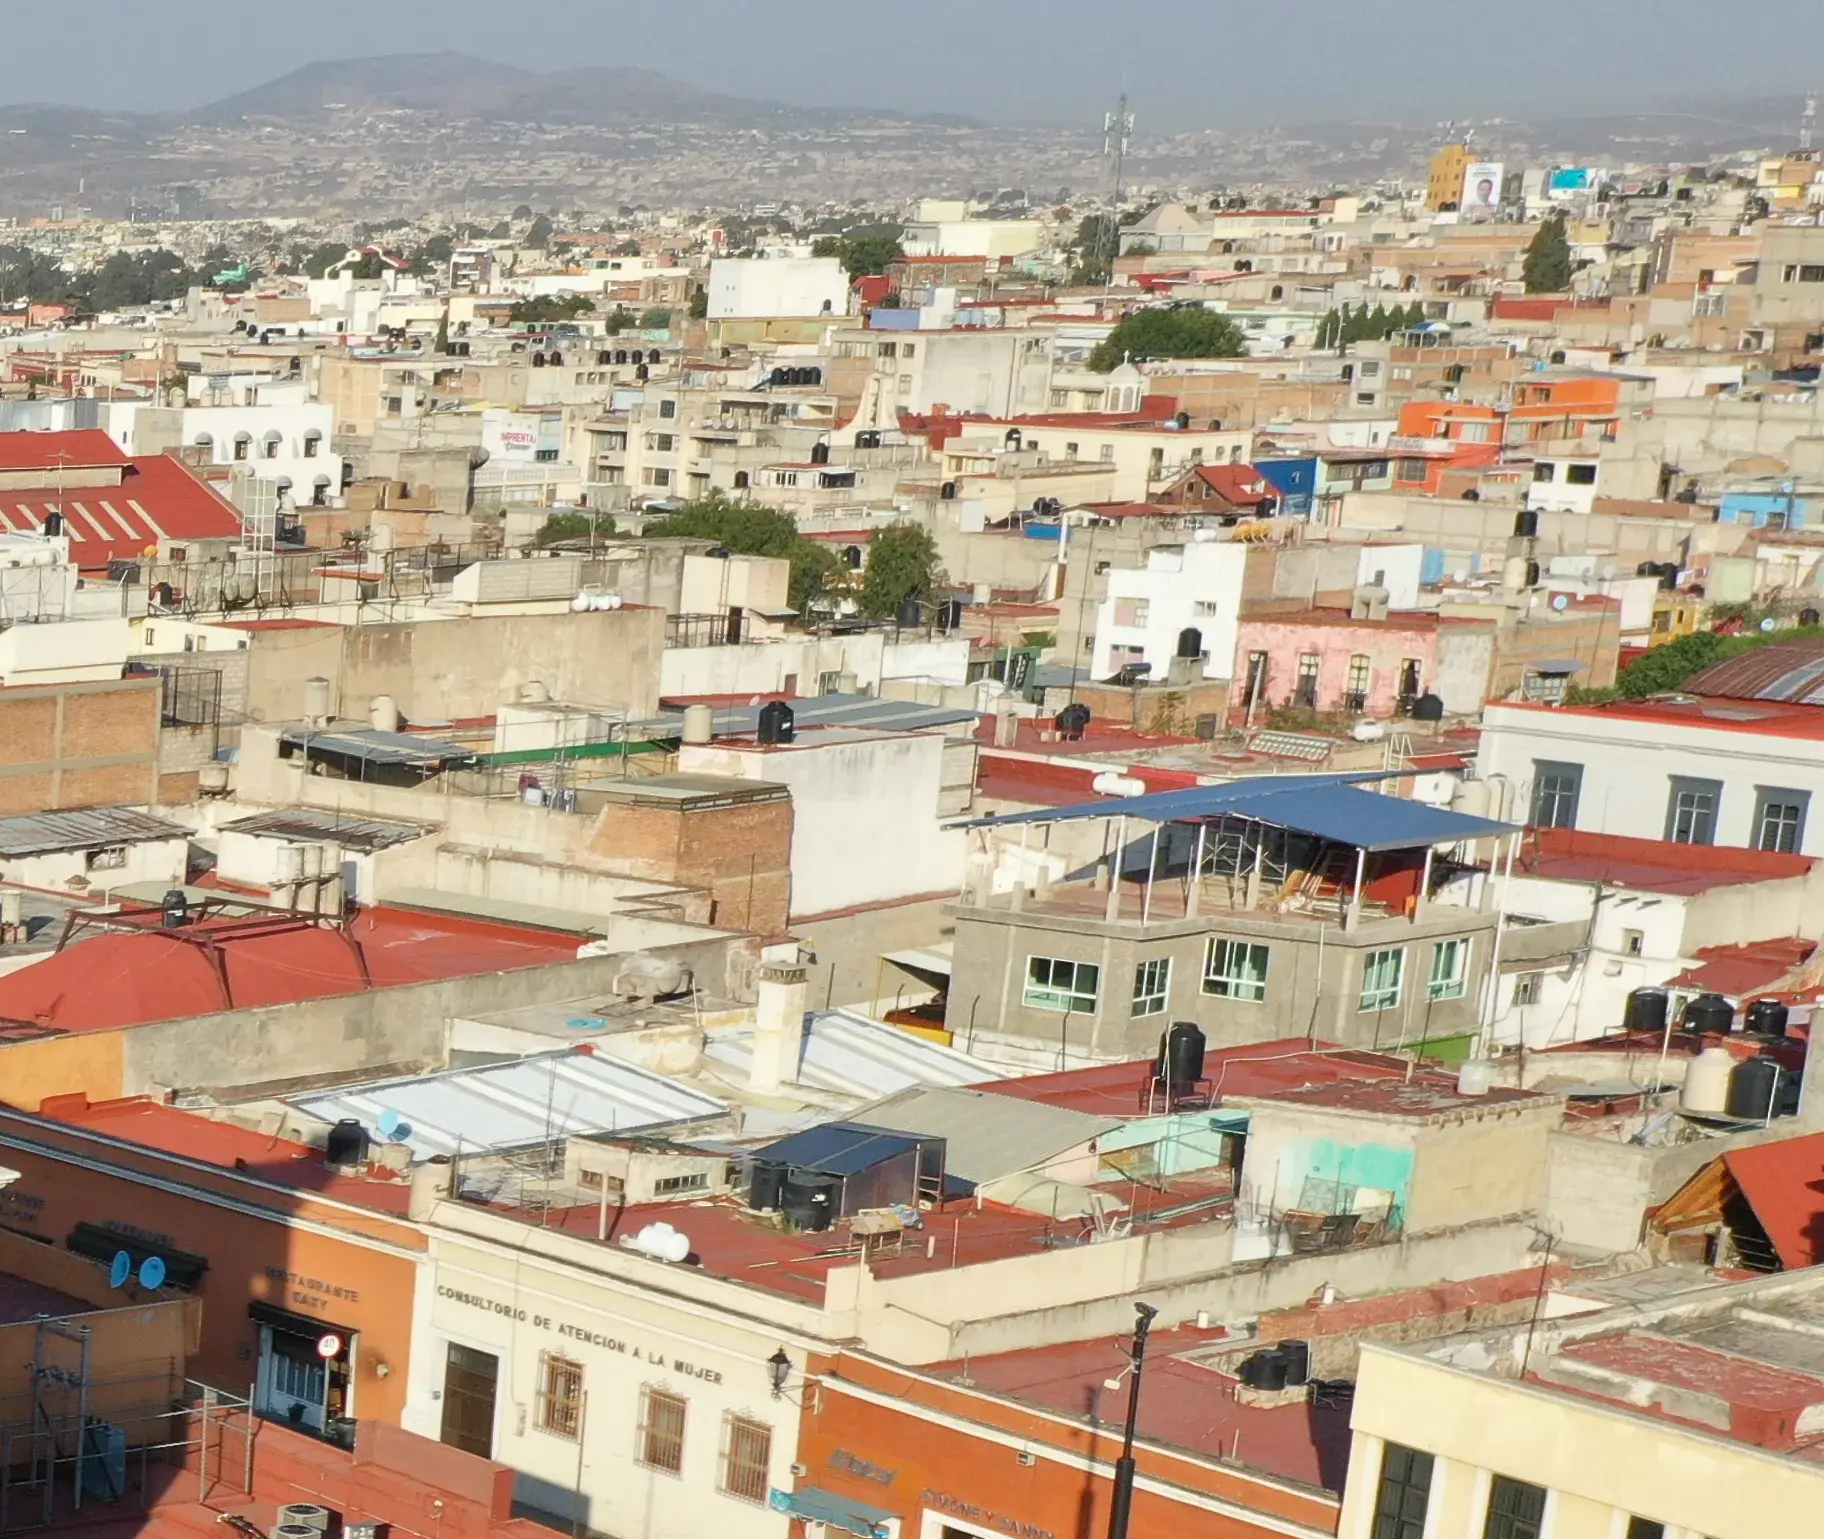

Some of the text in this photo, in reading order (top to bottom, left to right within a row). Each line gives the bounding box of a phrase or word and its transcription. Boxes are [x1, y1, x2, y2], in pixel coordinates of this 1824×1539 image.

[436, 1285, 723, 1386] CONSULTORIO DE ATENCION A LA MUJER
